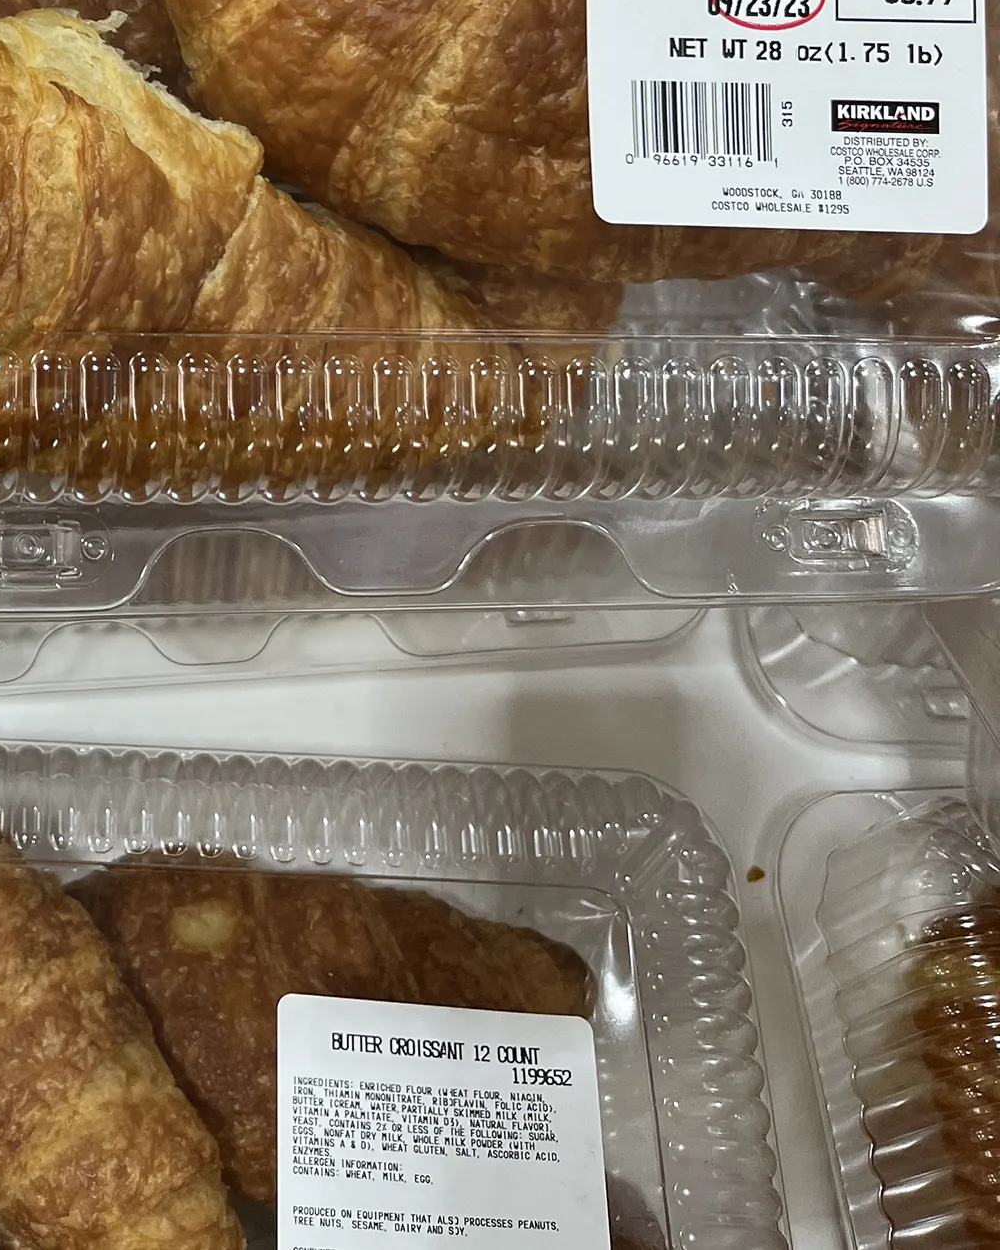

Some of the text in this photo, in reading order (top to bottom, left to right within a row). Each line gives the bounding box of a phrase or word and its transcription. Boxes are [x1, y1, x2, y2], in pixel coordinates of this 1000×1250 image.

[670, 38, 708, 58] NET
[722, 39, 748, 60] WT
[756, 40, 781, 60] 28
[907, 44, 943, 66] lb)
[782, 100, 792, 128] 315
[837, 104, 935, 122] KIRKLAND
[844, 137, 928, 148] DISTRIBUTED BY:
[830, 147, 864, 157] COSTCO
[866, 148, 914, 158] WHOLESALE
[626, 154, 634, 164] 0
[653, 154, 698, 166] 96619
[708, 156, 754, 168] 33116
[869, 158, 894, 166] BOX
[897, 158, 930, 168] 34535
[887, 167, 904, 177] WA
[906, 167, 934, 178] 98124
[846, 177, 869, 186] (800)
[872, 178, 914, 187] 774-2678
[811, 190, 842, 201] 30188
[712, 202, 749, 212] COSTCO
[756, 203, 811, 214] WHOLESALE
[332, 1033, 540, 1065] BUTTER CROISSANT 12 COUNT
[512, 1068, 572, 1086] 1199652
[293, 1157, 402, 1171] ALLERGEN INFORMATION:
[293, 1167, 339, 1178] CONTAINS:
[293, 1206, 336, 1217] PRODUCED
[341, 1209, 352, 1218] ON
[357, 1210, 405, 1221] EQUIPMENT
[411, 1213, 431, 1223] THAT
[464, 1216, 513, 1228] PROCESSES
